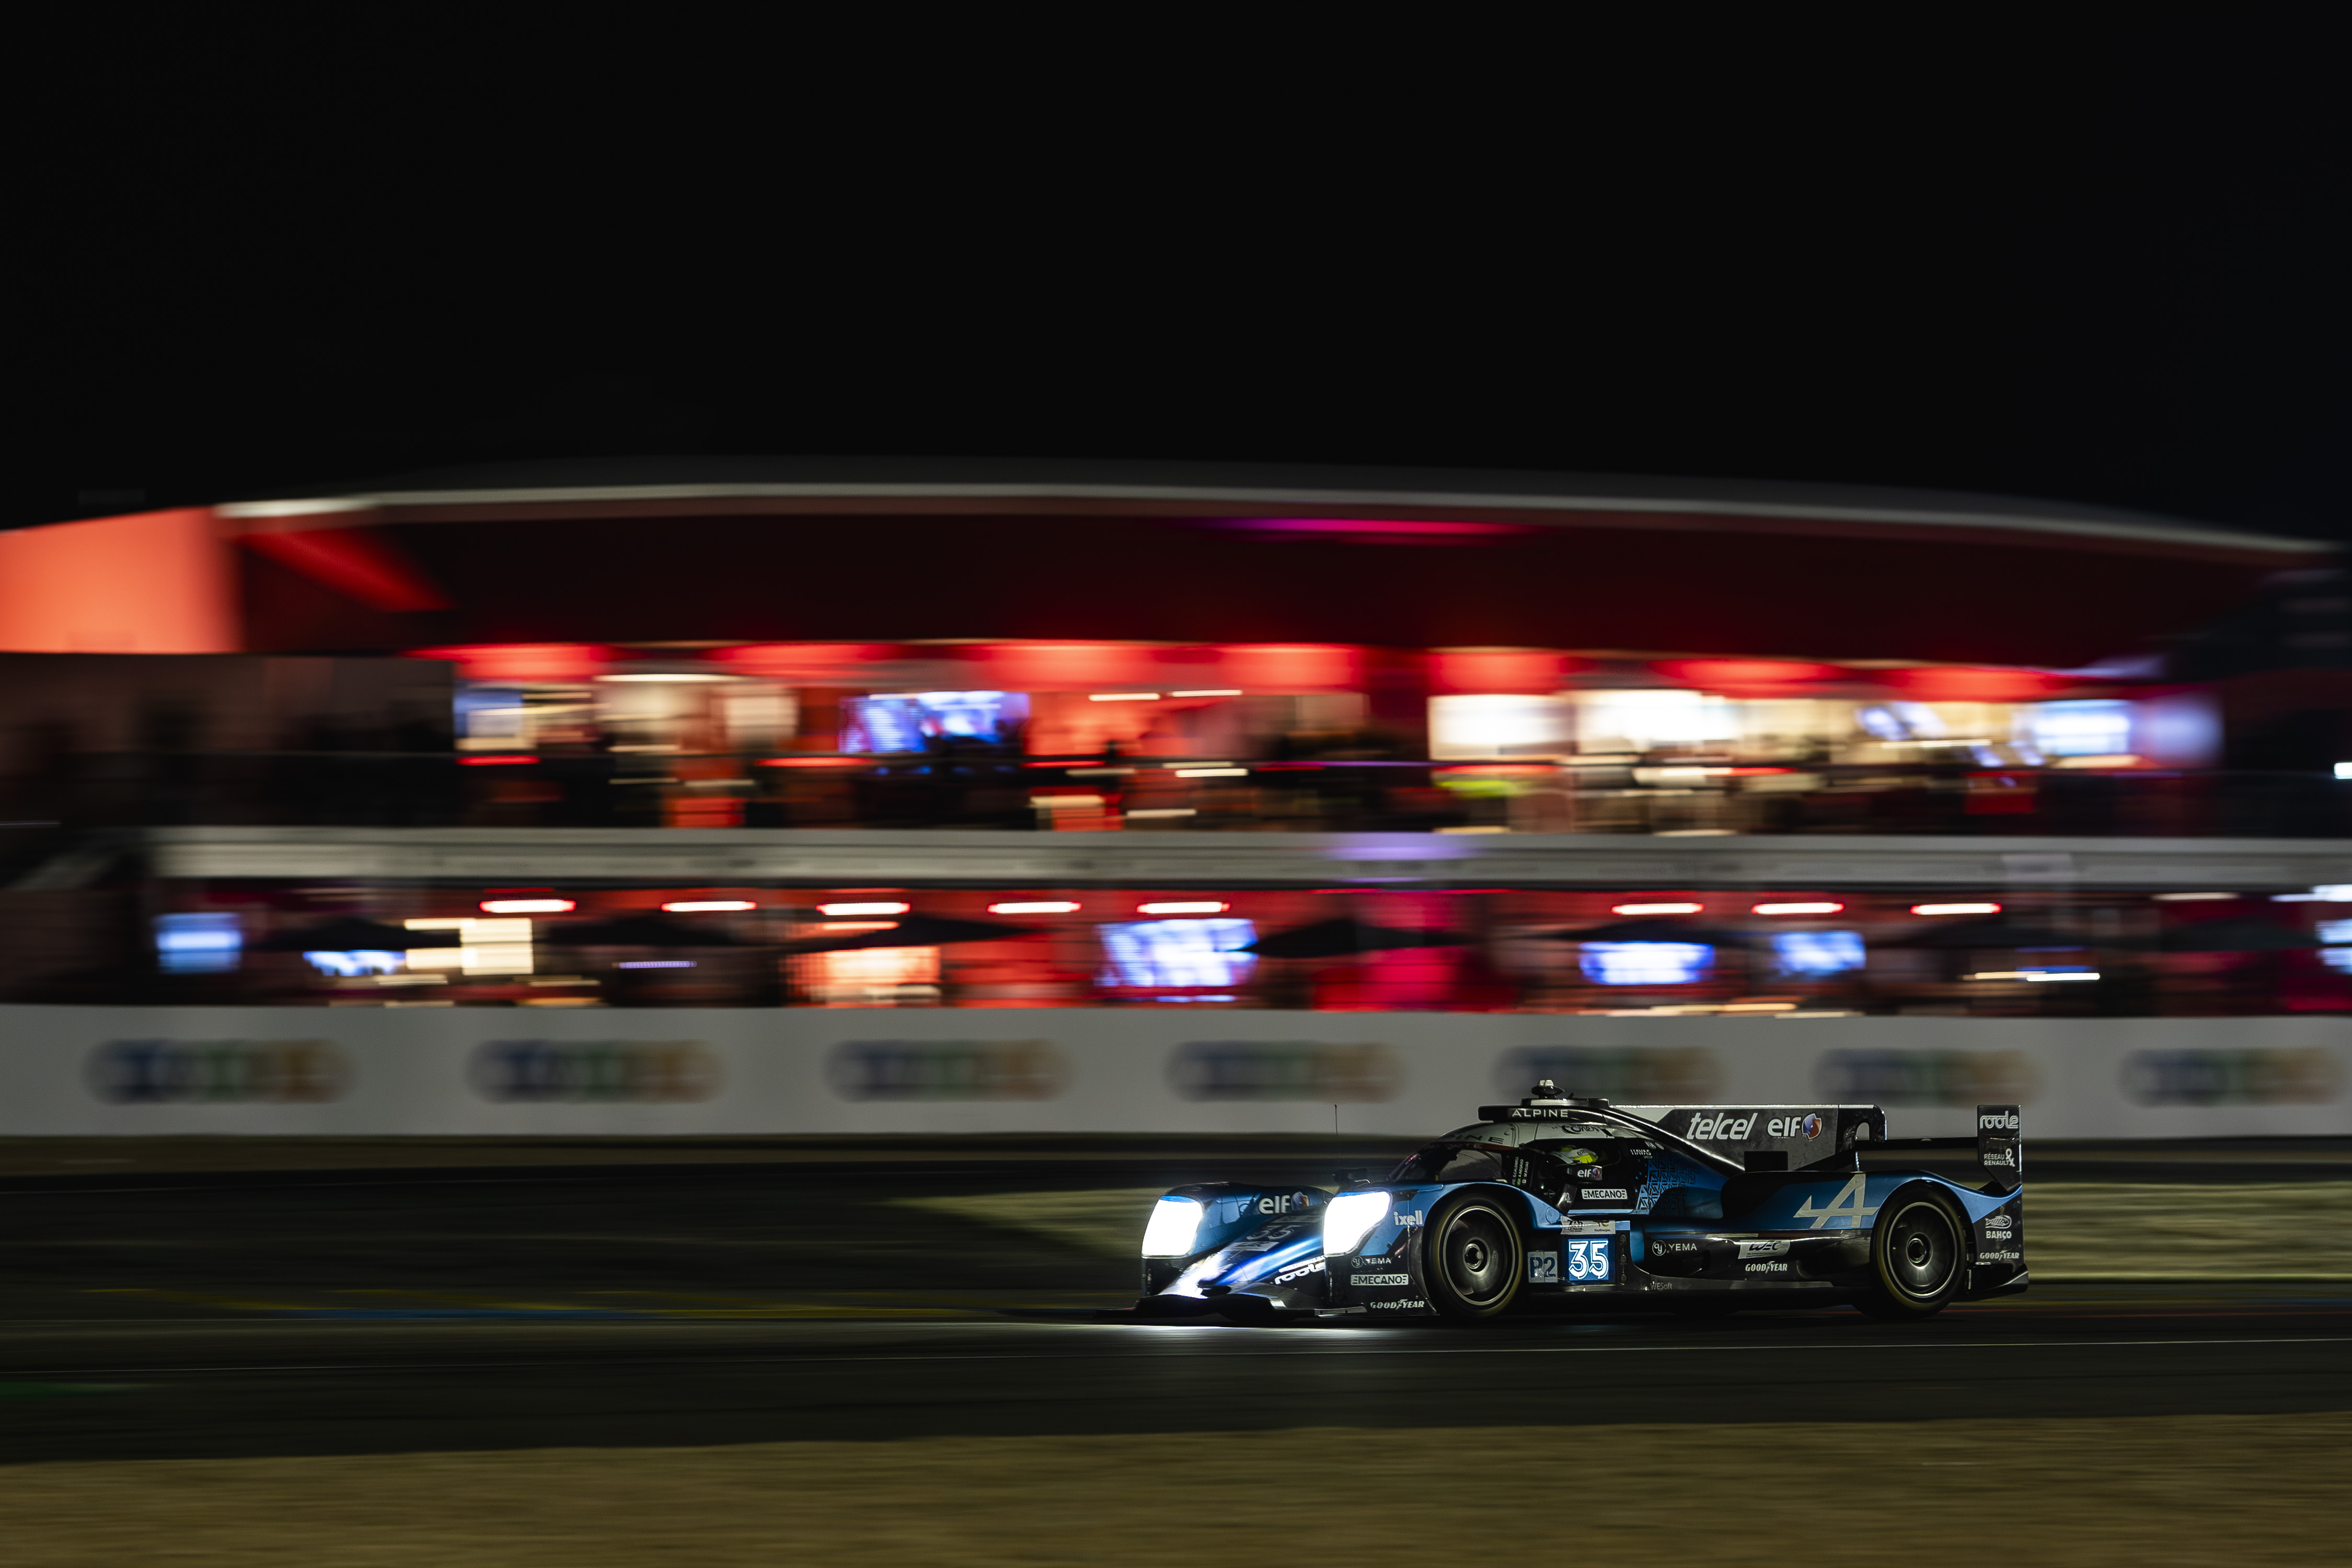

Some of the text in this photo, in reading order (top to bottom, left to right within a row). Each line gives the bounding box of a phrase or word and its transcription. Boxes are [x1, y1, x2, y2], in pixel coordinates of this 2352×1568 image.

[1512, 1109, 1569, 1118] ALPINE
[1980, 1111, 2019, 1129] roole
[1686, 1112, 1758, 1140] telcel
[1768, 1116, 1802, 1137] elf
[1577, 1169, 1592, 1178] elf
[1259, 1195, 1290, 1214] elf
[1393, 1209, 1423, 1226] ixell
[1986, 1231, 2012, 1240] BAHCO
[1668, 1243, 1698, 1251] YEMA
[1748, 1240, 1781, 1251] WEC
[1569, 1240, 1609, 1279] 35
[1530, 1256, 1556, 1278] P2
[1745, 1262, 1788, 1273] GOODYEAR
[1358, 1275, 1403, 1285] MECANO
[1650, 1282, 1673, 1290] WESoft
[1369, 1300, 1425, 1310] GOODYEAR
